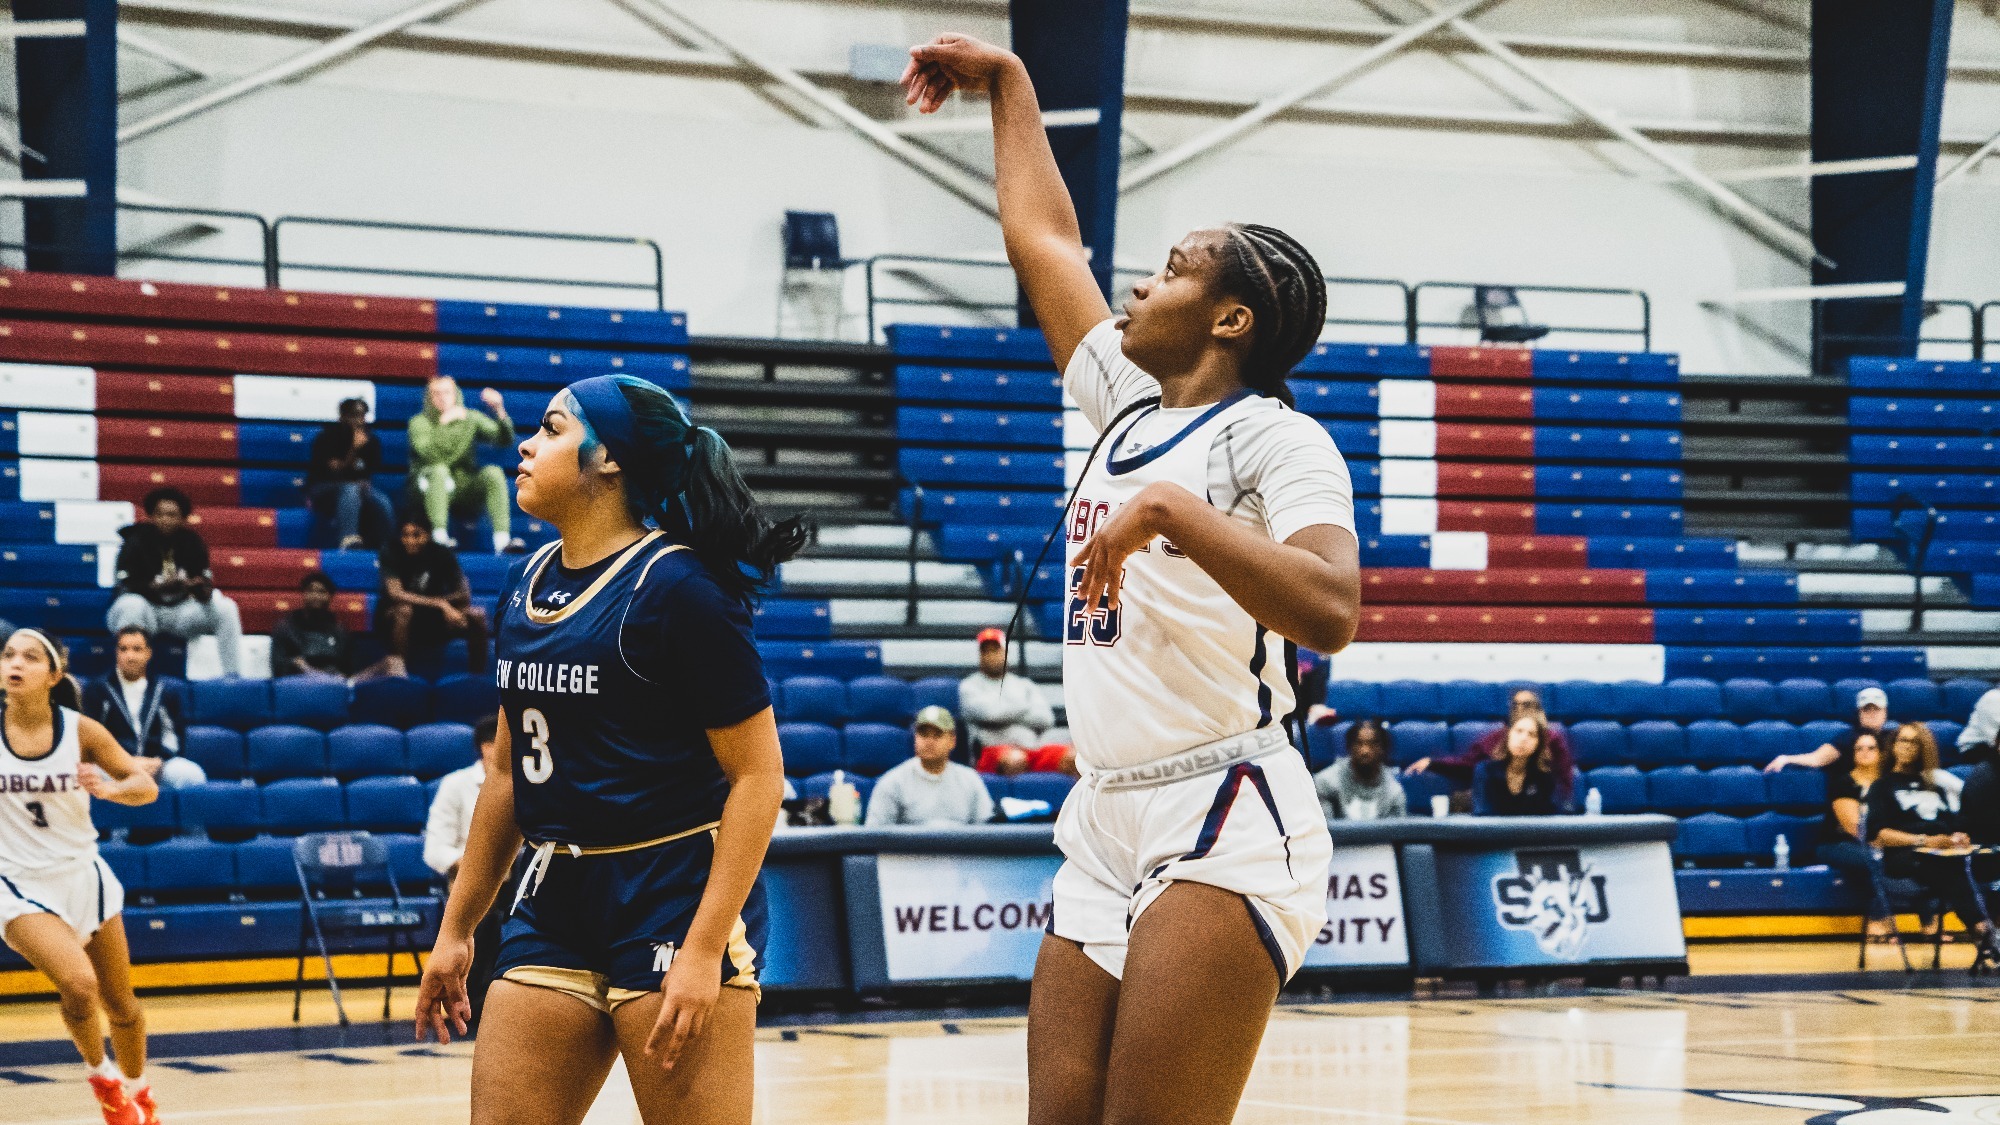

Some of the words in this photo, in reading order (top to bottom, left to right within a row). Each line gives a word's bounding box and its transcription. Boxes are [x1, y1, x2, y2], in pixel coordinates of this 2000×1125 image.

[517, 662, 599, 694] COLLEGE
[522, 707, 554, 784] 3
[25, 801, 49, 828] 3
[895, 902, 1051, 933] WELCOM
[1315, 916, 1396, 945] SITY
